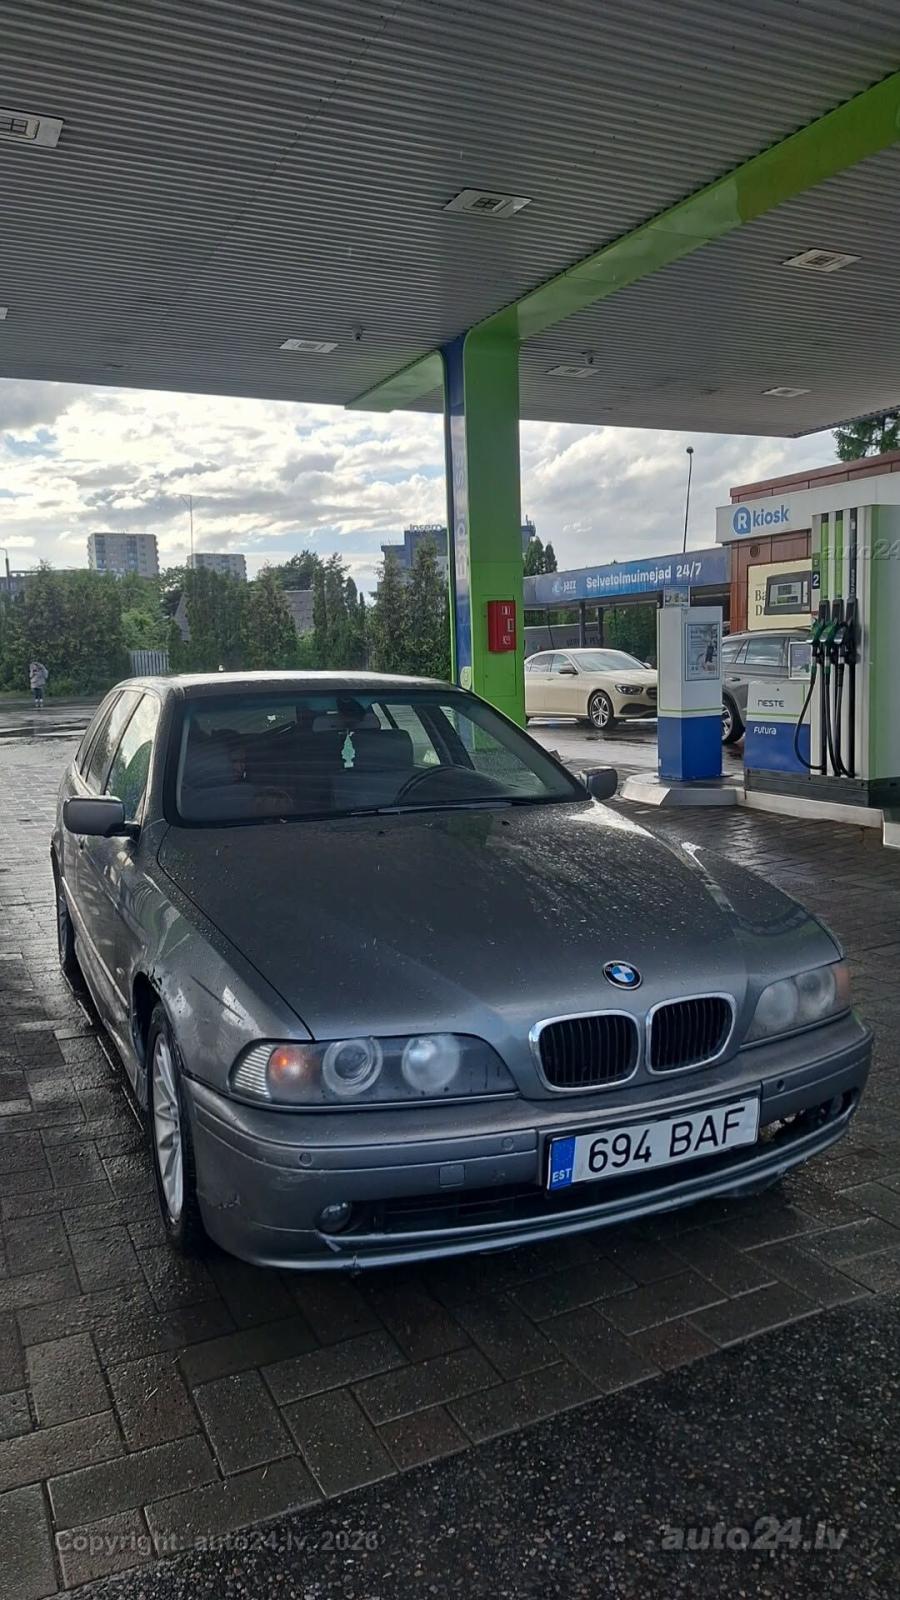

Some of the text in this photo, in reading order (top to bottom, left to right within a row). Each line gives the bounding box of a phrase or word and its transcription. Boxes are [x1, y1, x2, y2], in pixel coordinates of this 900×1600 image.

[752, 505, 790, 528] kiosk
[586, 562, 702, 589] Selvetolmuimejad 24/7
[812, 574, 820, 587] 2
[753, 726, 777, 735] Futura
[588, 1106, 746, 1173] 694 BAF
[552, 1168, 572, 1183] EST
